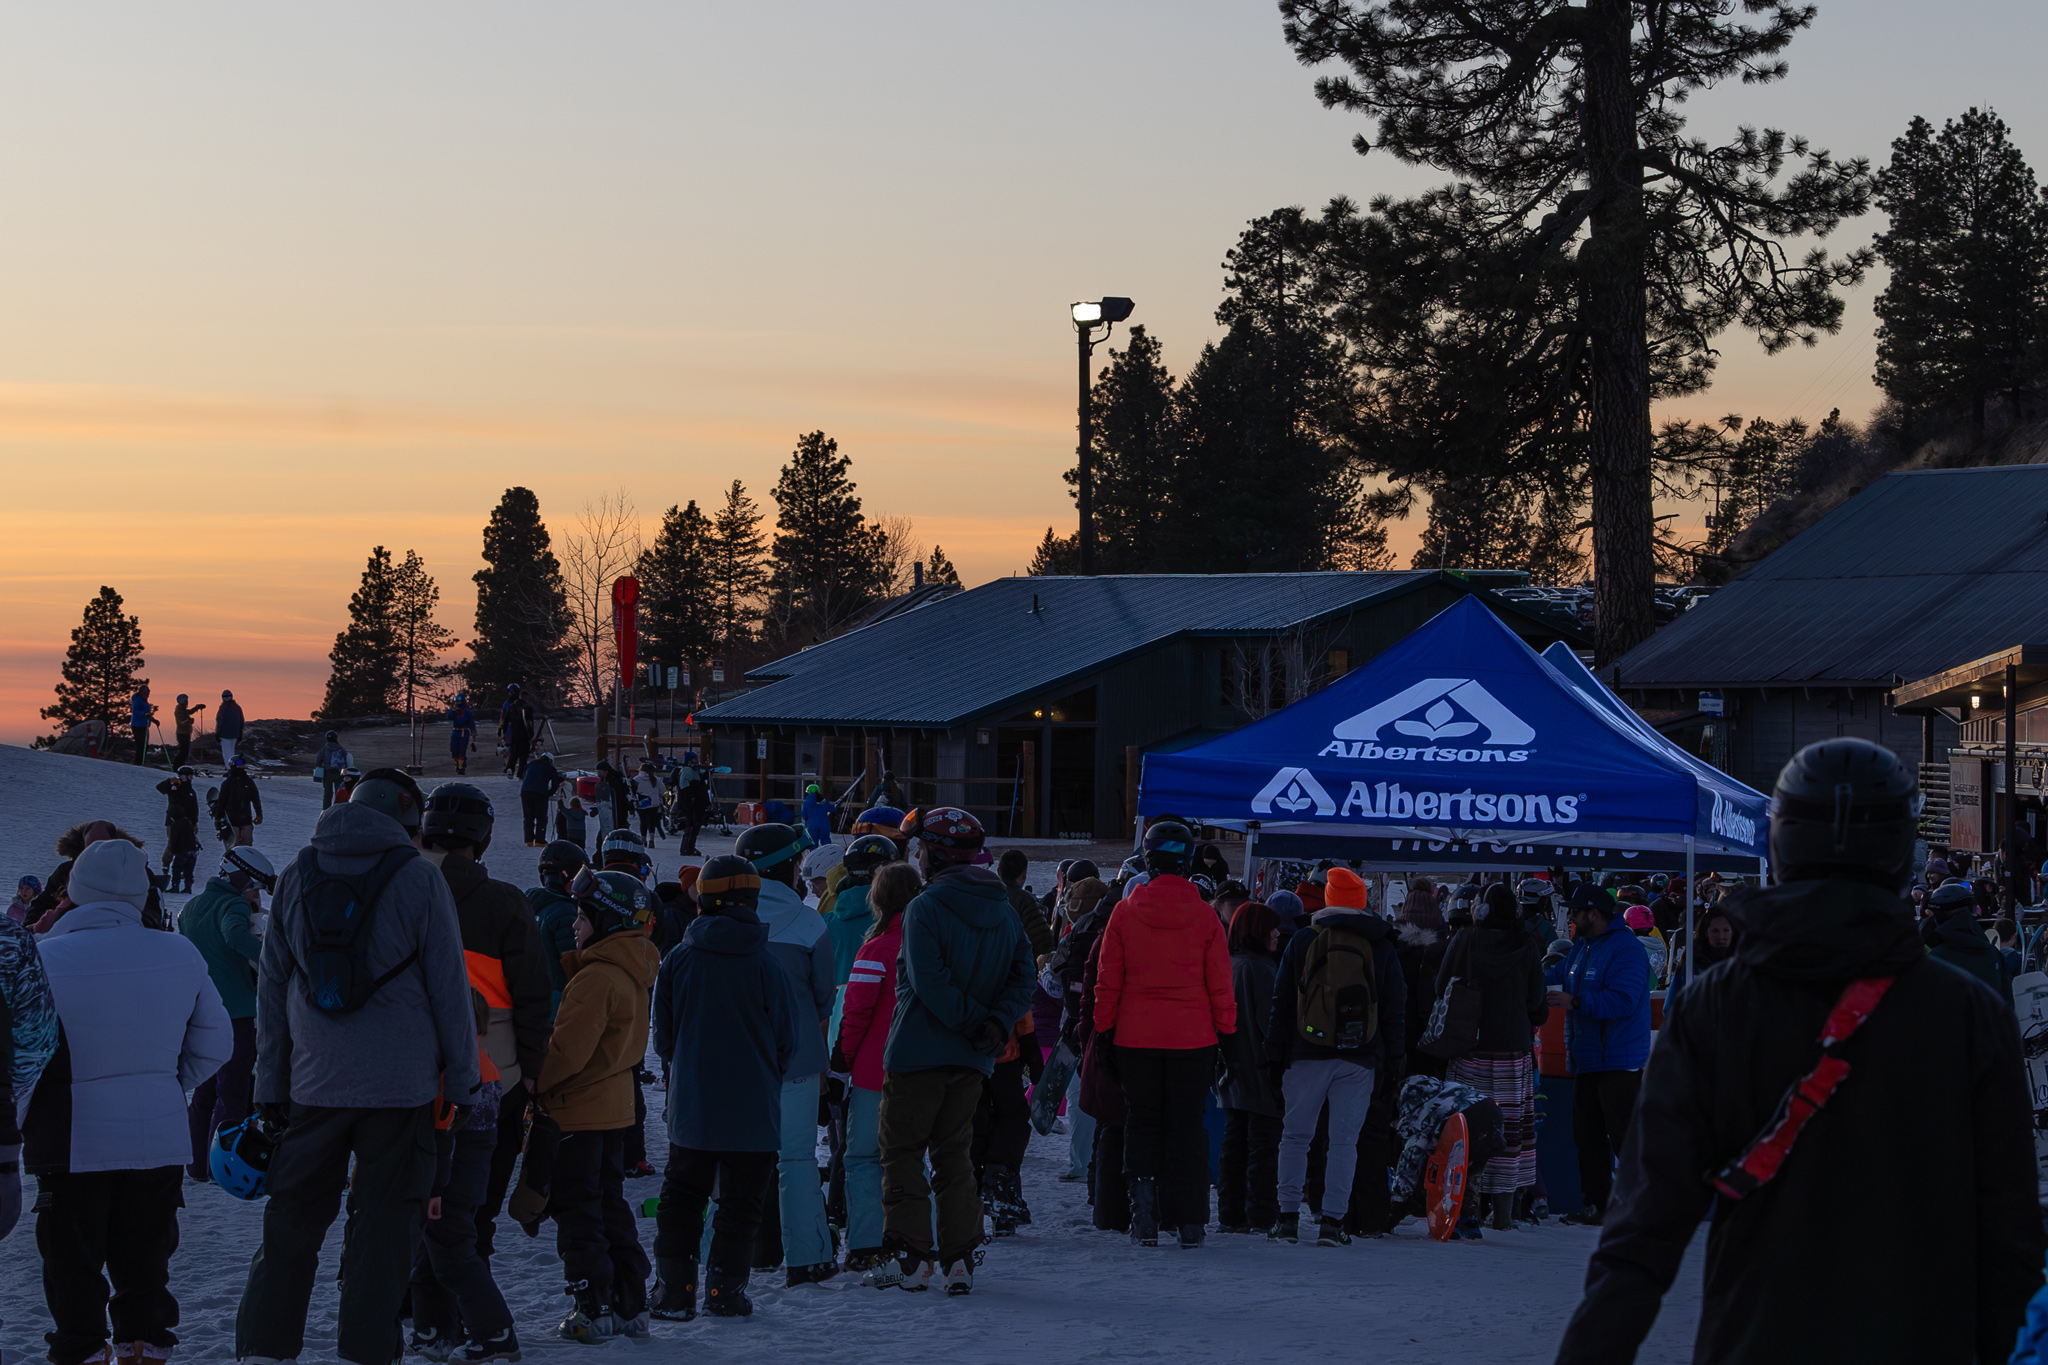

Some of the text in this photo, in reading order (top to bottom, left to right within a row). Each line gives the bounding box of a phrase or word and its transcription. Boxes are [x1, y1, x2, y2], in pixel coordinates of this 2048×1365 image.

[1317, 740, 1530, 762] Albertsons
[1340, 780, 1579, 824] Albertsons
[601, 896, 632, 917] DRAGON
[873, 1273, 905, 1287] DALBELLO
